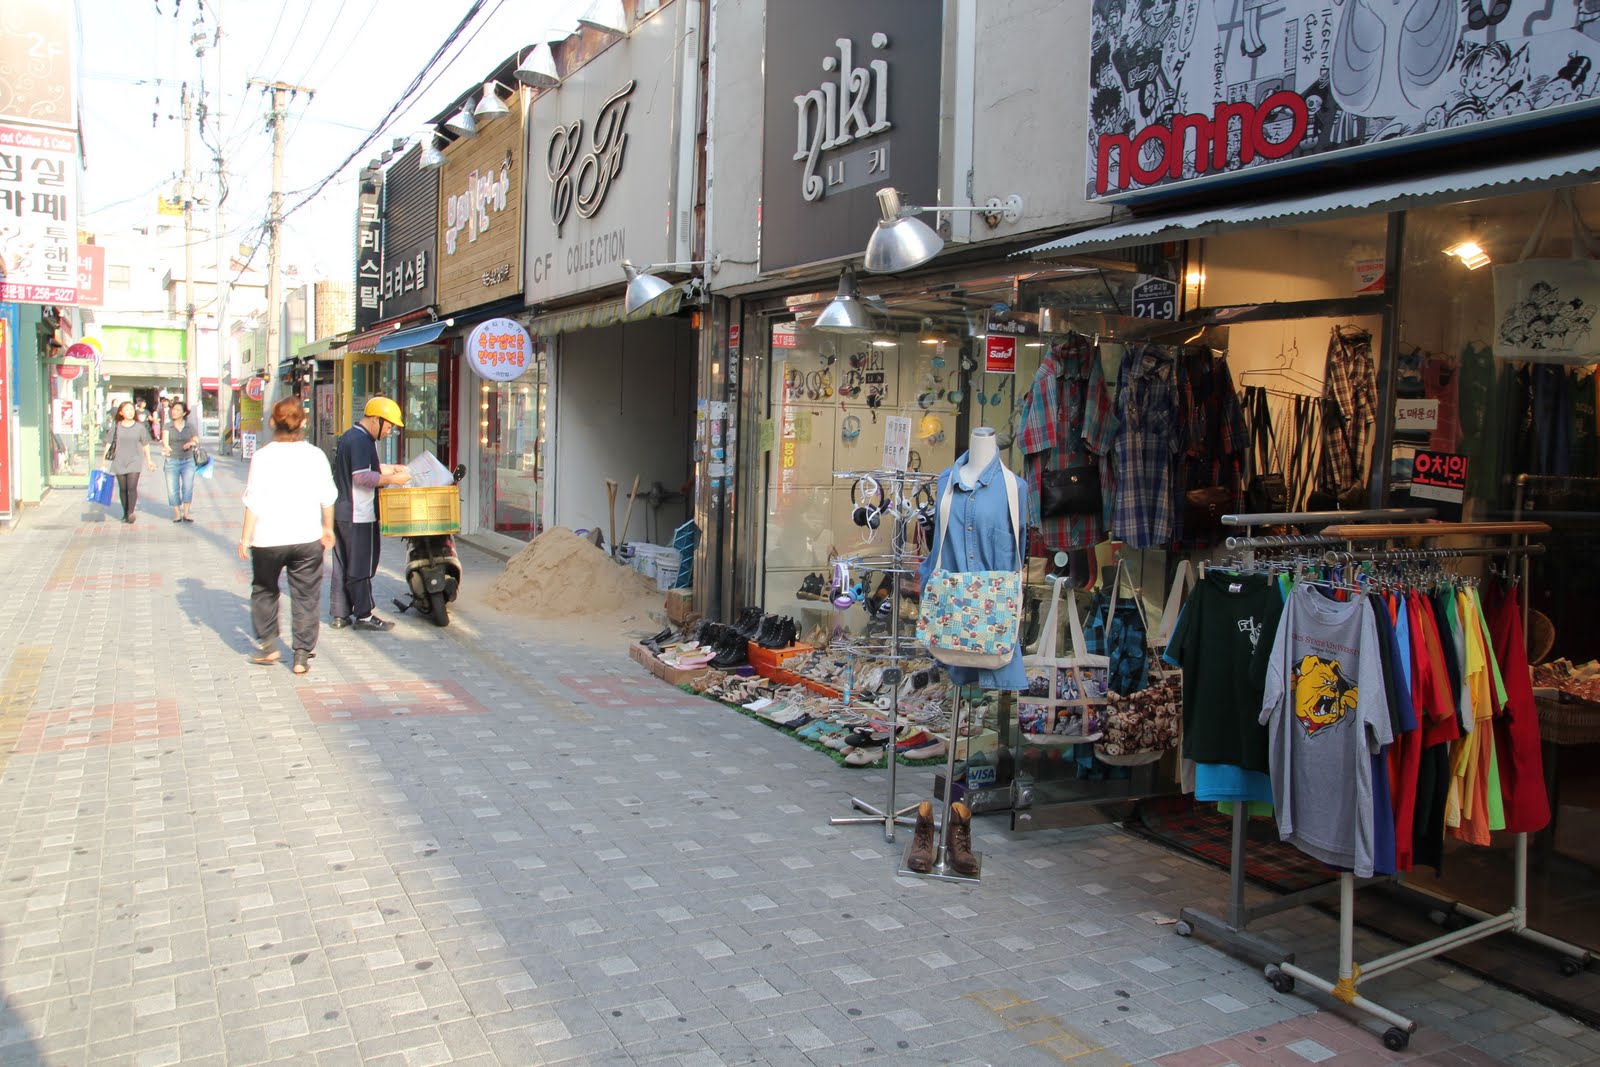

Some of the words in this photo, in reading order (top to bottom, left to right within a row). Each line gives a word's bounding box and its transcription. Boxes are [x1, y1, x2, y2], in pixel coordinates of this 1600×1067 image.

[793, 32, 892, 201] niki
[359, 202, 380, 309] 크리스탈
[384, 251, 426, 300] 크리스탈
[534, 252, 552, 283] CF
[566, 228, 626, 276] COLLECTION
[1136, 300, 1174, 320] 21-9
[1398, 408, 1436, 420] 도매문의
[1411, 453, 1468, 488] 오천원
[970, 768, 995, 780] VISA
